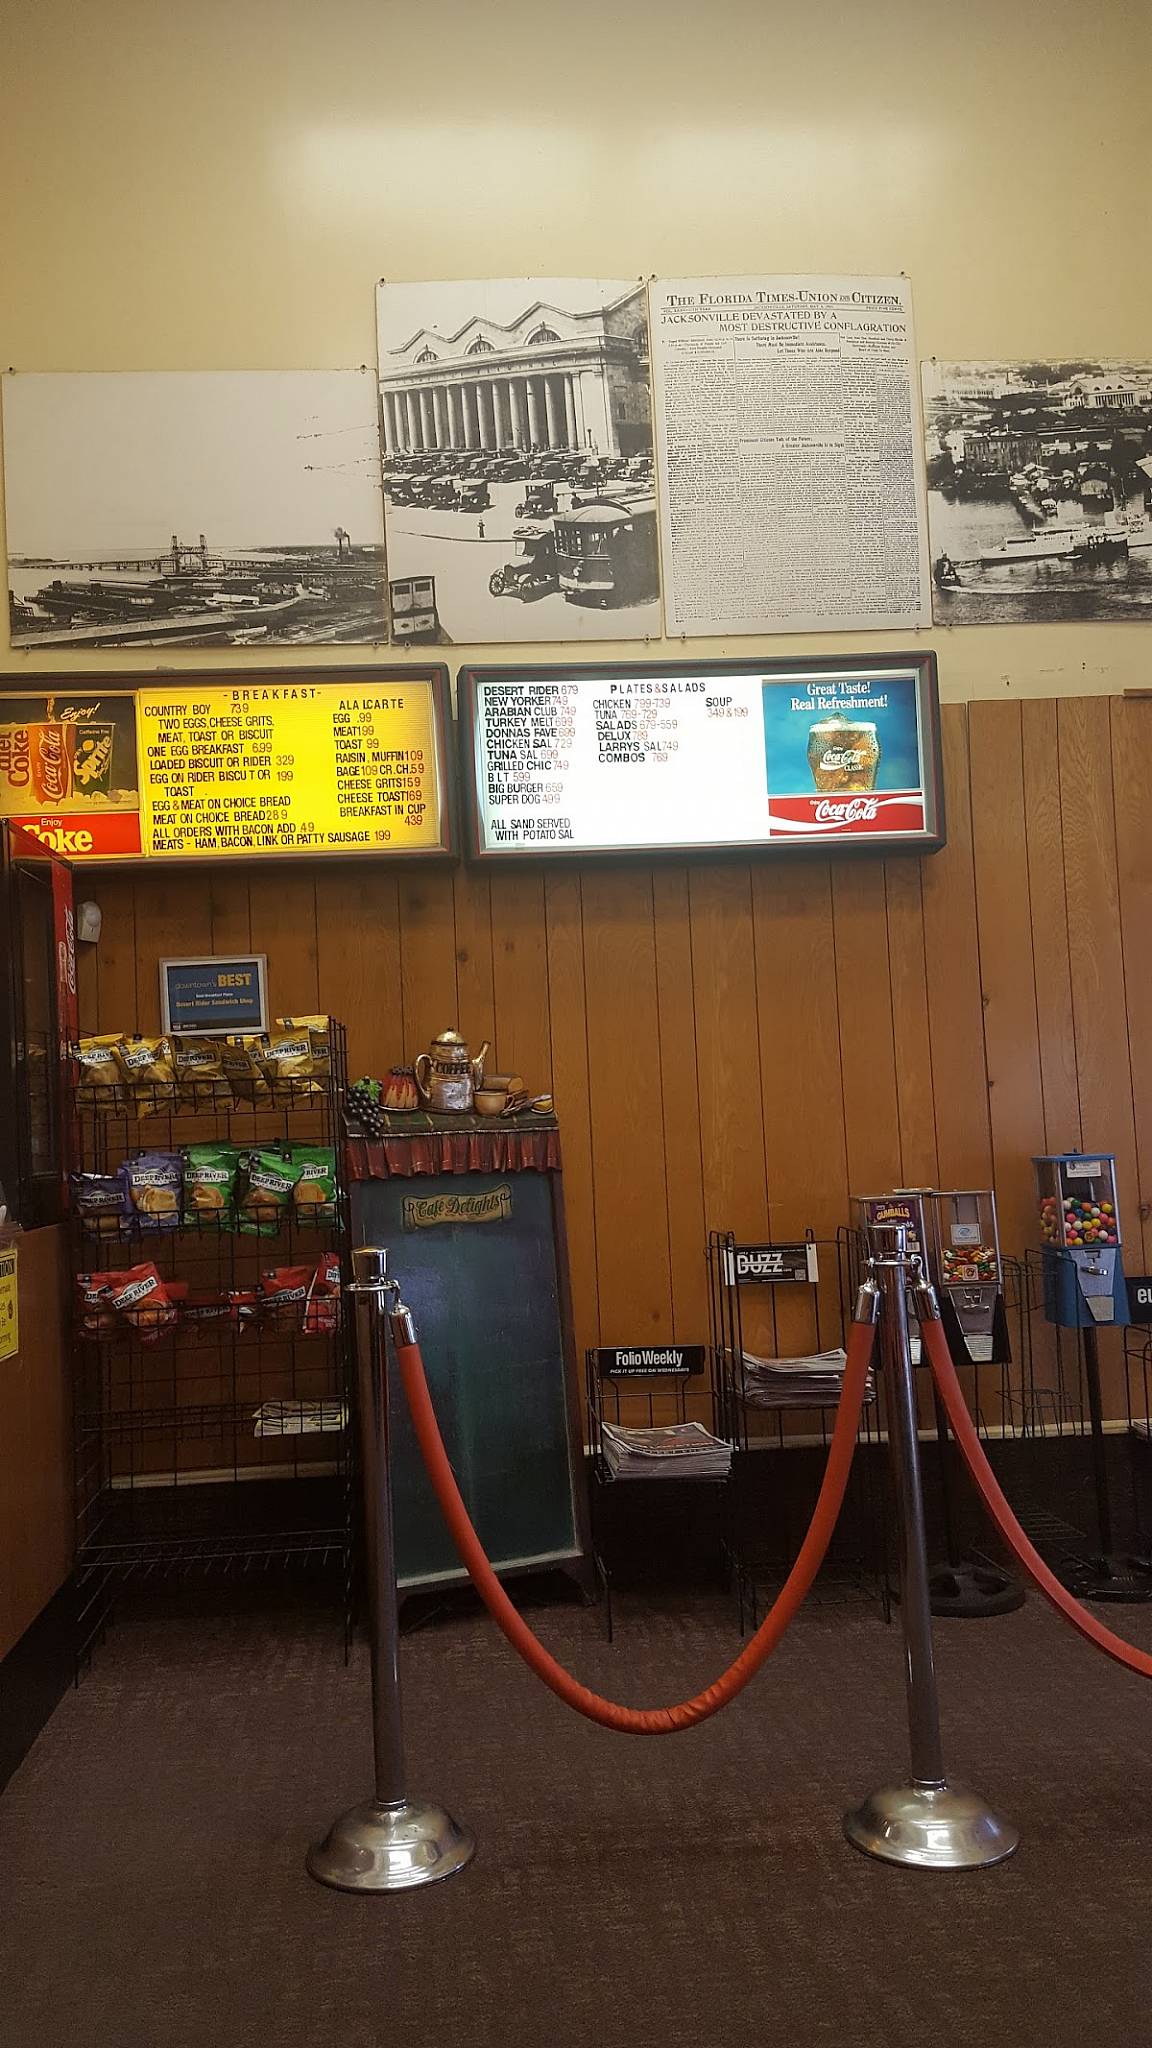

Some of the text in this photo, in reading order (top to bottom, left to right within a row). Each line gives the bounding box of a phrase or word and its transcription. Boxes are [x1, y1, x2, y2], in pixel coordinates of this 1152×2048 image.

[661, 311, 837, 324] JACKSONVILLE DEVASTATED BY A
[720, 321, 906, 332] MOST DESTRUCTIVE CONFLAGRATION
[484, 685, 578, 696] DESERT RIDER 679
[807, 681, 871, 696] Great Taste!
[484, 697, 509, 706] NEW
[510, 696, 551, 706] YORKER
[593, 699, 631, 709] CHICKEN
[705, 697, 733, 707] SOUP
[790, 694, 888, 711] Real Refreshment!
[60, 703, 100, 721] Enjoy!
[144, 703, 249, 717] COUNTRY BOY 739
[484, 707, 558, 717] ARABIAN CLUB
[595, 710, 618, 720] TUNA
[158, 718, 180, 730] TWO
[333, 713, 350, 724] EGG
[485, 717, 553, 727] TURKEY MELT
[596, 720, 637, 730] SALADS
[188, 729, 274, 742] TOAST OR BISCUIT
[486, 728, 558, 738] DONNAS FAVE
[598, 731, 631, 741] DELUX
[147, 743, 244, 757] ONE EGG BREAKFAST
[334, 738, 380, 750] TOAST 99
[486, 739, 552, 749] CHICKEN SAL
[599, 741, 662, 752] LARRYS SAL
[8, 730, 30, 787] Coke
[487, 750, 517, 760] TUNA
[519, 750, 538, 759] SAL
[598, 752, 645, 763] COMBOS
[39, 726, 64, 800] Coca-Cola
[150, 755, 294, 771] LOADED BISCUIT OR RIDER 329
[487, 760, 552, 771] GRILLED CHIC
[150, 769, 294, 784] EGG ON RIDER OR 199
[513, 772, 531, 782] 599
[337, 779, 372, 790] CHEESE
[488, 783, 543, 794] BIG BURGER
[164, 786, 195, 797] TOAST
[223, 796, 291, 808] CHOICE BREAD
[338, 792, 373, 804] CHEESE
[488, 794, 519, 805] SUPER
[521, 794, 541, 804] DOG
[196, 810, 266, 823] CHOICE BREAD
[340, 804, 426, 817] BREAKFAST IN CUP
[41, 818, 62, 827] Enjoy
[405, 815, 423, 826] 439
[491, 818, 571, 830] ALL SAND SERVED
[173, 823, 296, 838] ORDERS WITH BACON ADD
[495, 829, 574, 841] WITH POTATO SAL
[257, 830, 391, 846] LINK PATTY SAUSAGE 199
[217, 973, 251, 987] BEST
[285, 1044, 306, 1054] RIVER
[187, 1171, 228, 1180] DEEP RIVER
[252, 1174, 292, 1190] DEEP RIVER
[445, 1195, 501, 1215] Delights
[877, 1207, 910, 1220] GUMBALLS
[736, 1253, 784, 1274] BUZZ
[115, 1279, 155, 1307] DEEP RIVER
